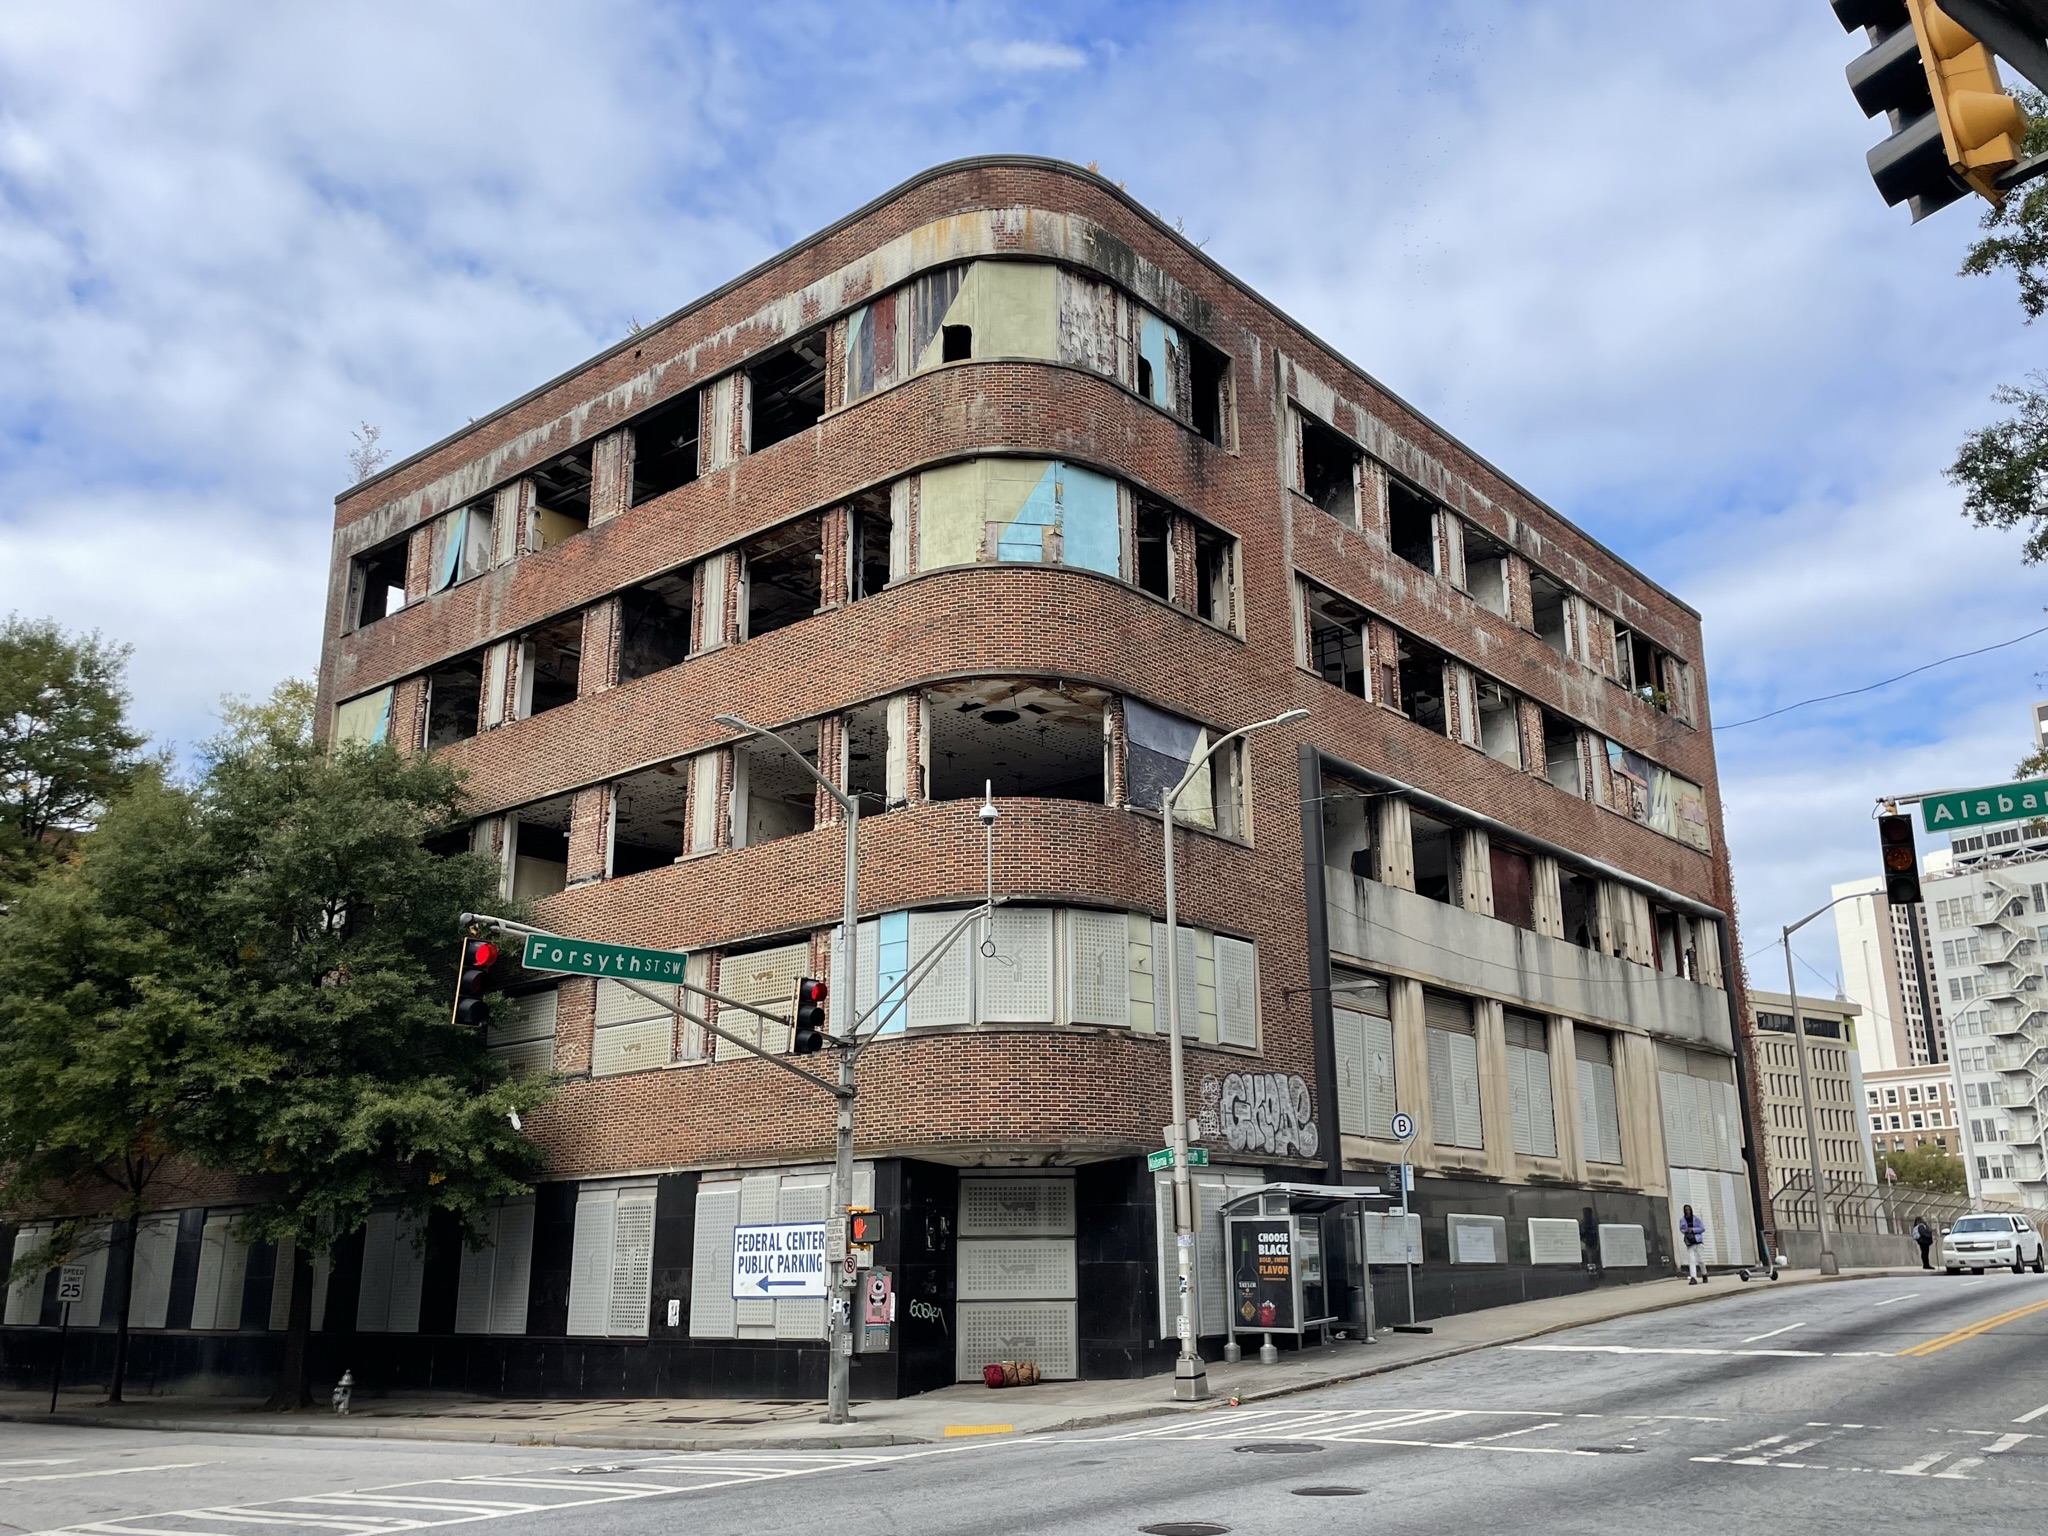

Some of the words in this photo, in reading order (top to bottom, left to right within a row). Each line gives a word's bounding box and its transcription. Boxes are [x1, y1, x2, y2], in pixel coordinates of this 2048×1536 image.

[1933, 791, 2048, 823] Alaba
[531, 943, 640, 972] Forsyth
[644, 959, 660, 972] ST
[663, 961, 681, 975] SW
[751, 971, 774, 981] VPS
[749, 1026, 771, 1036] VS
[622, 1042, 642, 1053] VPS
[1398, 1119, 1407, 1132] B
[1000, 1201, 1036, 1211] VPS
[736, 1232, 782, 1252] FEDERAL
[786, 1230, 825, 1251] CENTER
[1258, 1233, 1289, 1243] CHOOSE
[738, 1254, 774, 1274] PUBLIC
[777, 1253, 822, 1273] PARKING
[1000, 1264, 1036, 1275] VPS
[1259, 1265, 1289, 1275] FLAVOR
[60, 1283, 80, 1297] 25
[1000, 1336, 1036, 1347] VPS
